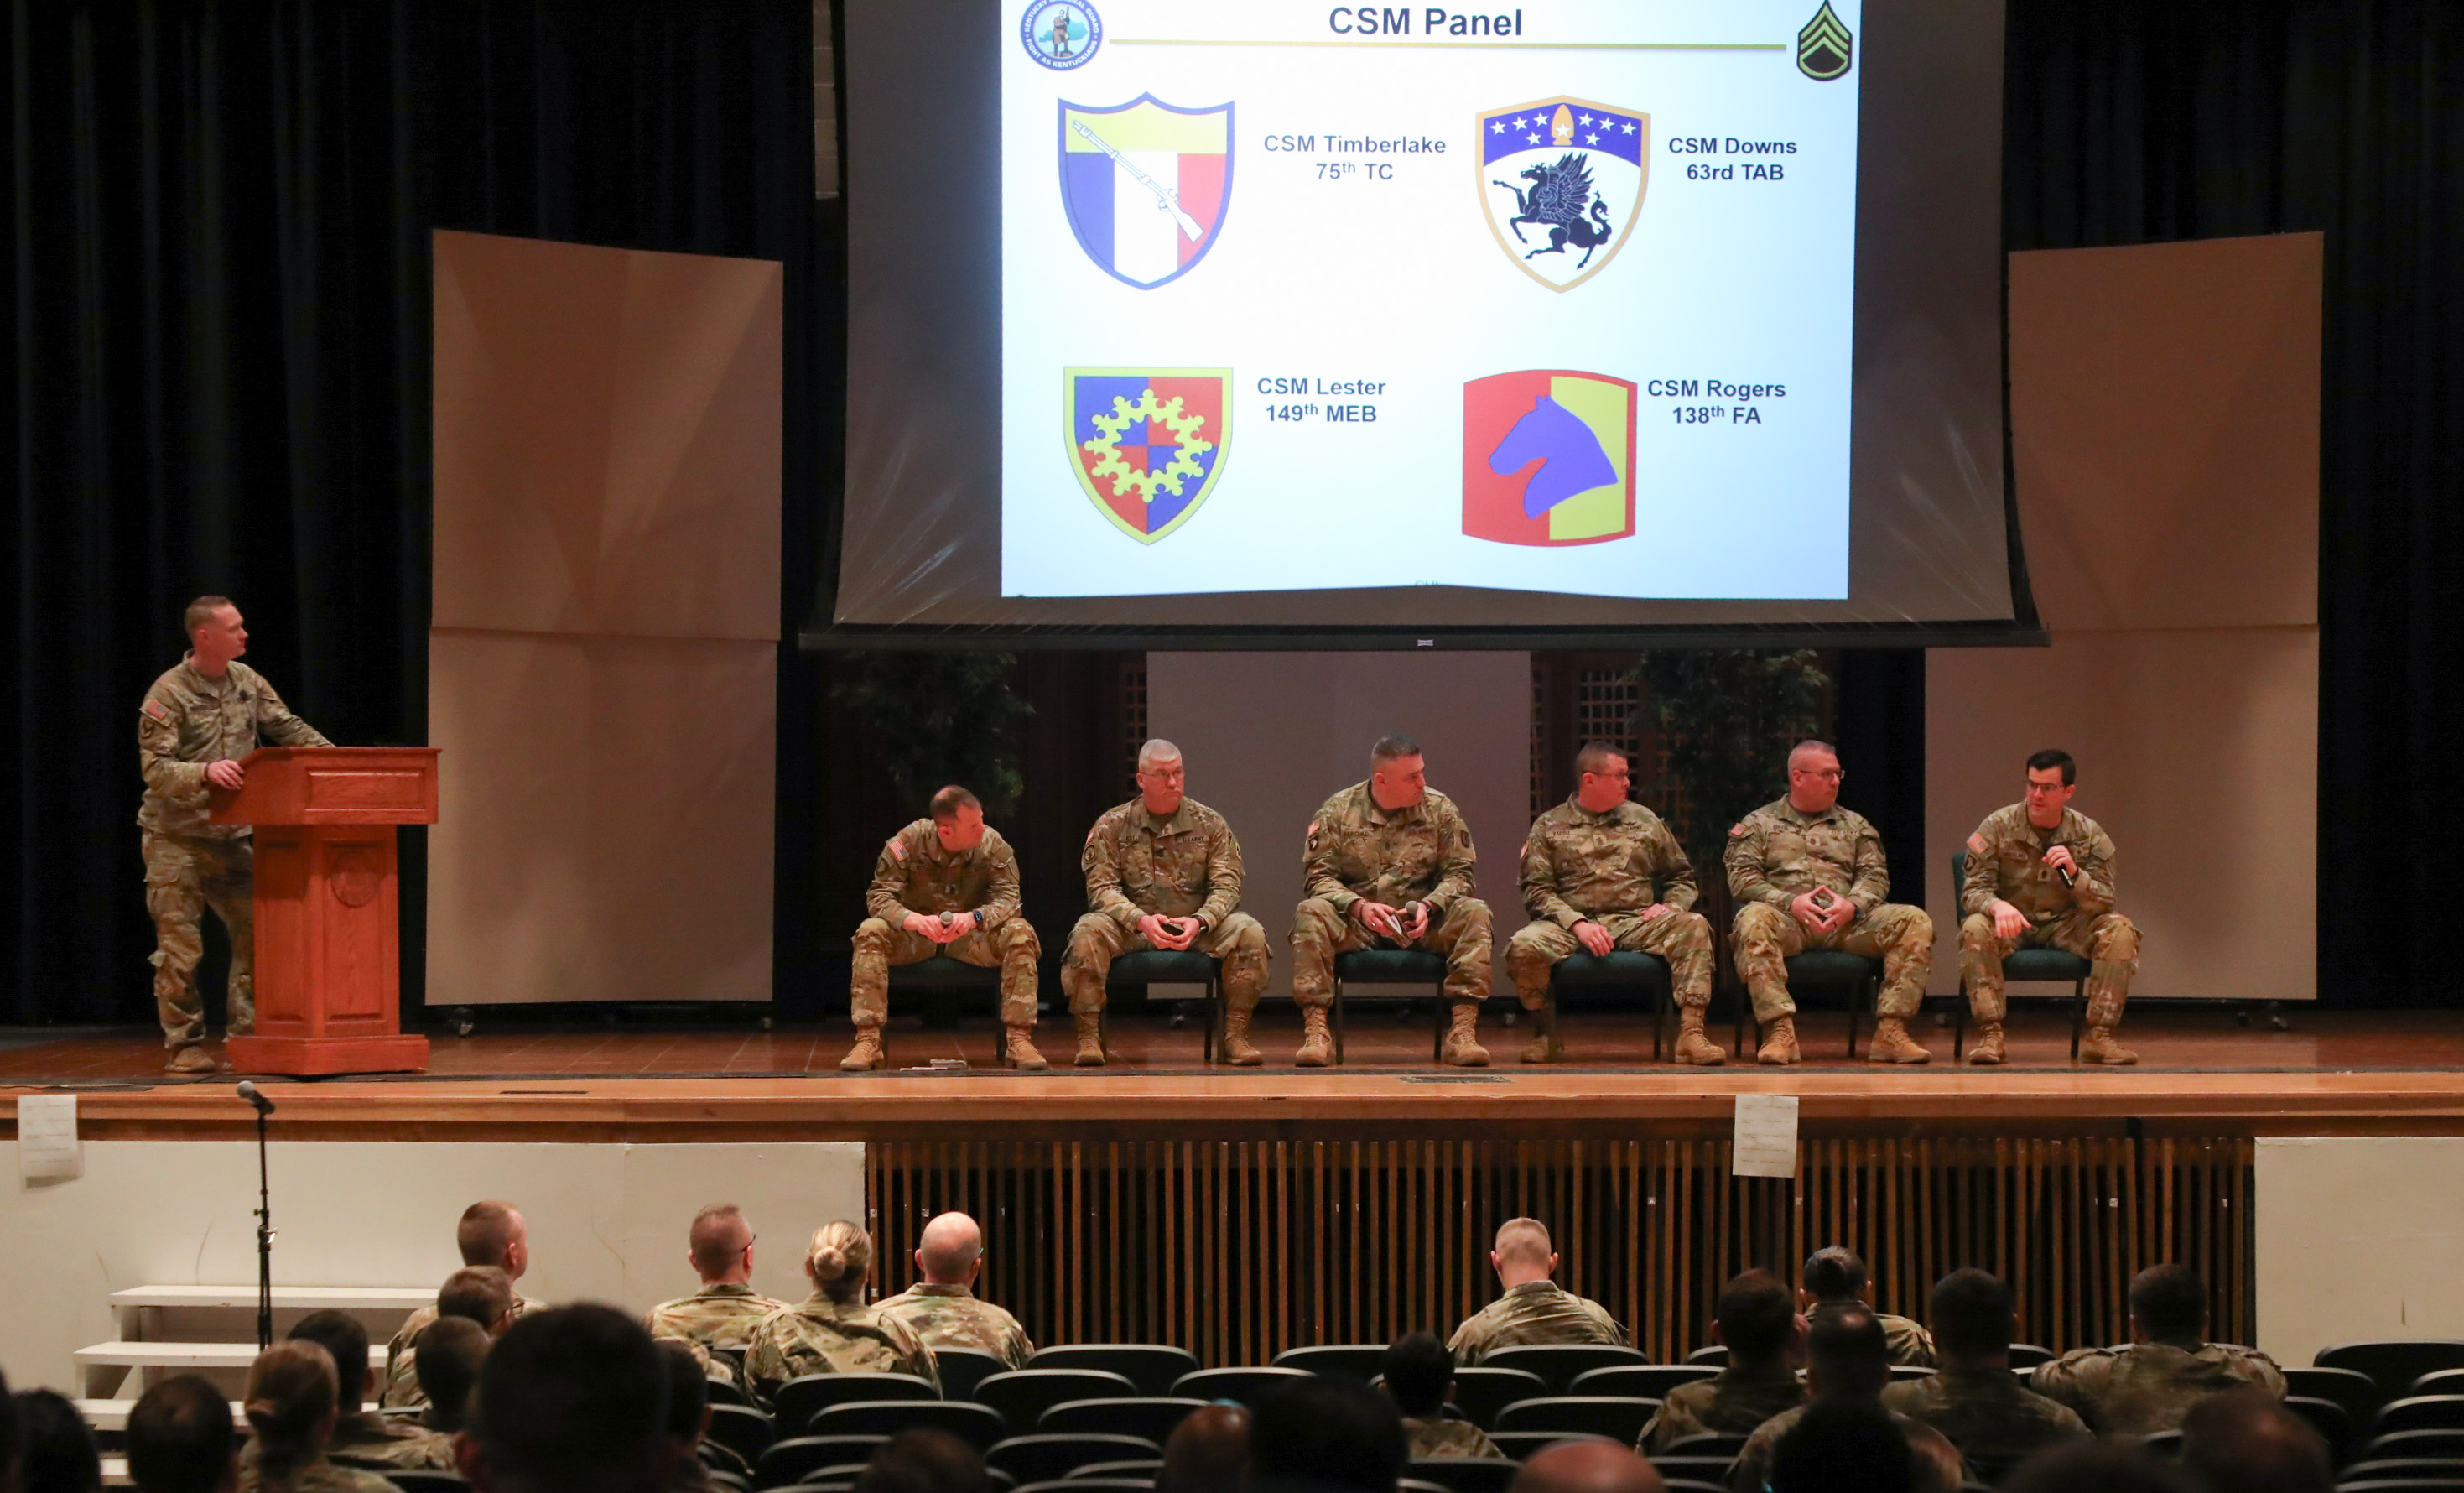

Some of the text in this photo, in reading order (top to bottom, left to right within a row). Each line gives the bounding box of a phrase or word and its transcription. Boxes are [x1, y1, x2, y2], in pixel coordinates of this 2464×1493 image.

[1085, 8, 1099, 34] GUARD
[1329, 7, 1522, 36] CSM Panel
[1026, 39, 1098, 68] FIGHT AS KENTUCKIANS
[1264, 134, 1447, 153] CSM Timberlake
[1668, 137, 1797, 154] CSM Downs
[1316, 161, 1393, 180] 75th TC
[1687, 164, 1785, 181] 63rd TAB
[1257, 377, 1386, 395] CSM Lester
[1647, 379, 1786, 401] CSM Rogers
[1266, 403, 1377, 423] 149th MEB
[1672, 404, 1762, 424] 138th FA
